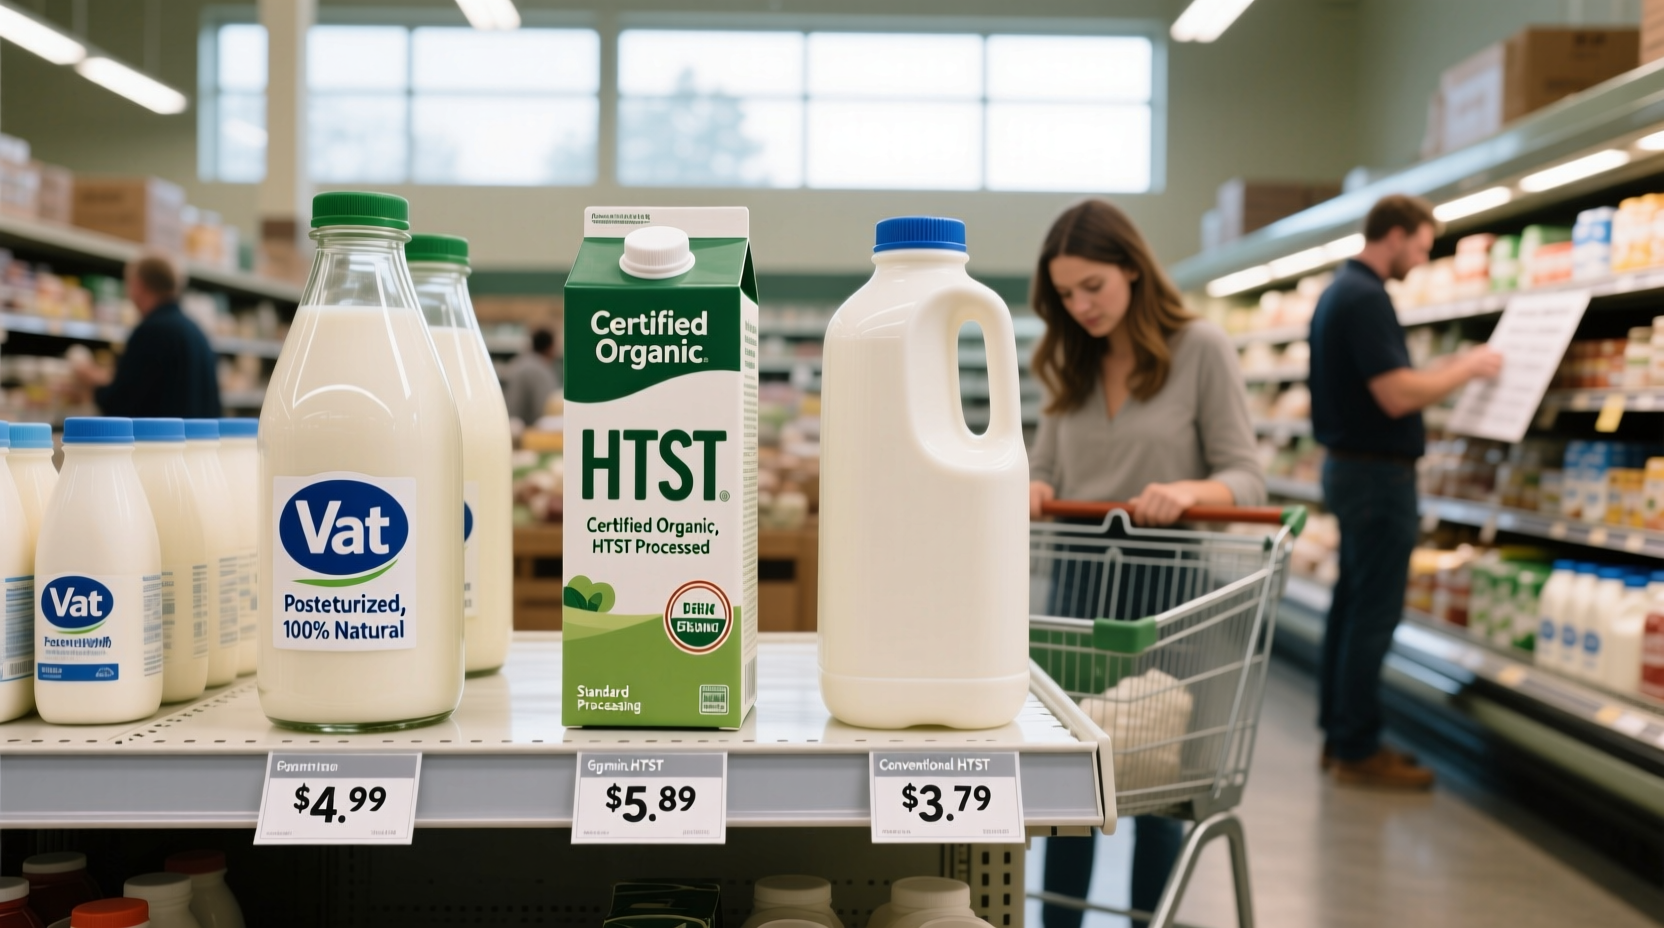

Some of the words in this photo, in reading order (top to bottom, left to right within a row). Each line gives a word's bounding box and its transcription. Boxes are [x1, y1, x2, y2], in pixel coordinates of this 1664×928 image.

[591, 309, 708, 336] Certified
[595, 338, 703, 370] Organic
[582, 429, 728, 501] HTST
[295, 500, 390, 555] Vat
[656, 517, 719, 538] Organic,
[592, 538, 632, 554] HTST
[635, 539, 710, 555] Processed
[49, 587, 103, 617] Vat
[284, 593, 406, 617] Posteturized,
[283, 620, 330, 640] 100%
[335, 619, 405, 640] Natural
[577, 684, 629, 698] Standard
[630, 758, 665, 772] HTST
[879, 757, 954, 771] Conventional
[957, 758, 990, 772] HTST
[293, 782, 387, 824] $4.99
[606, 782, 696, 823] $5.89
[902, 782, 992, 823] $3.79
